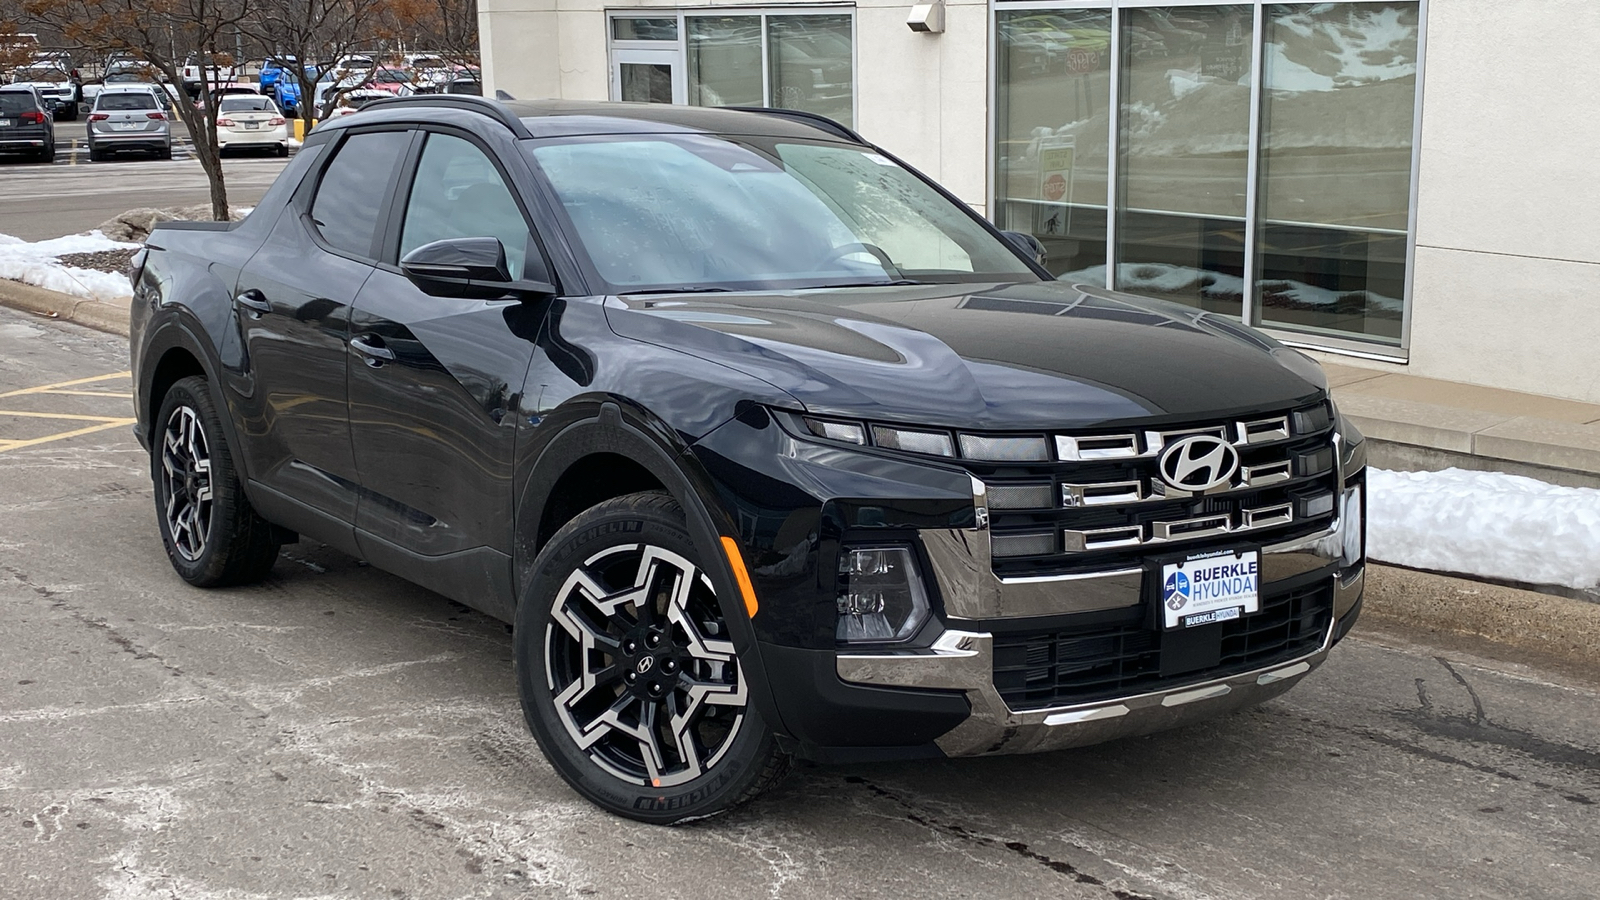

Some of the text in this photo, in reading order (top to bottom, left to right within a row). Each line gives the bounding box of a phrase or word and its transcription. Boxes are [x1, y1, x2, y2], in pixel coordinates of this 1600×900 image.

[559, 521, 638, 560] MICHELIN
[1193, 561, 1257, 583] BUERKLE
[1193, 575, 1257, 602] HYUNDAI
[1186, 612, 1216, 625] BUERKLE
[638, 776, 723, 811] MICHELIN
